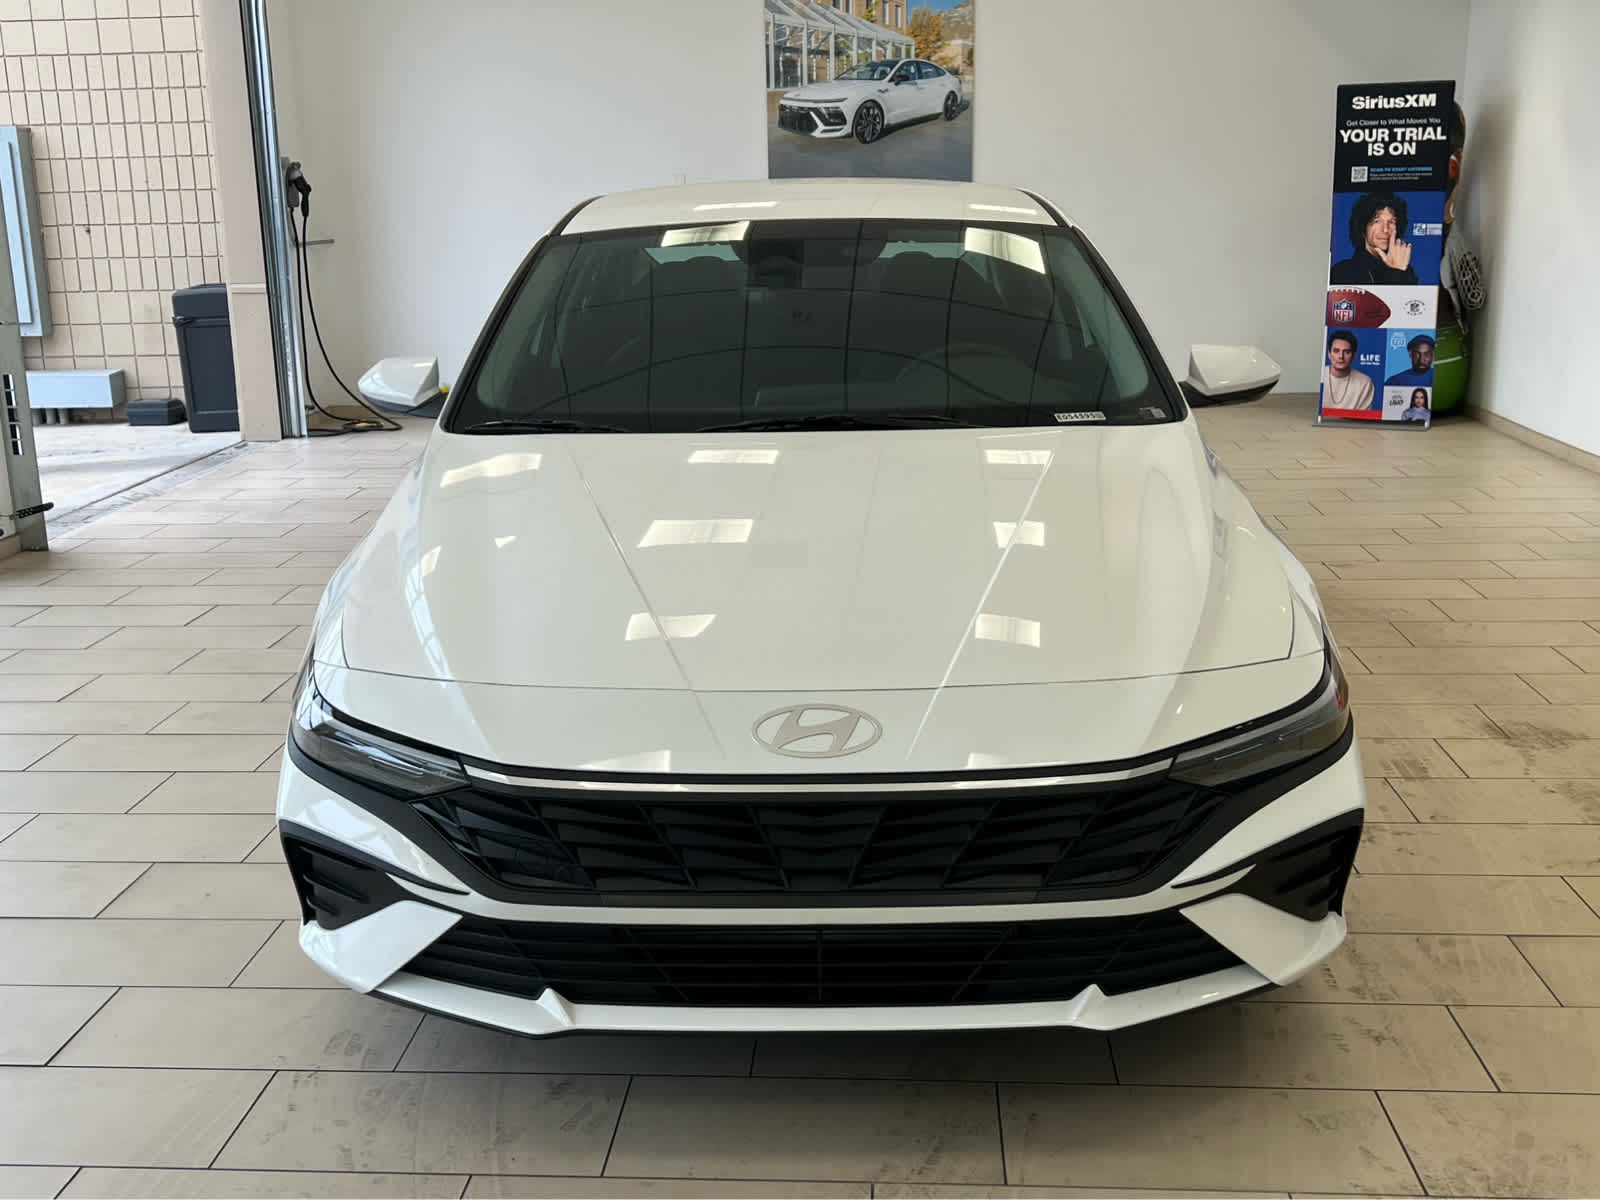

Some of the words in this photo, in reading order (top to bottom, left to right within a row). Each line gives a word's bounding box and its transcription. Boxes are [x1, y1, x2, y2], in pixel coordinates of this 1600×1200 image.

[1352, 93, 1437, 110] SiriusXM
[1339, 128, 1389, 143] YOUR
[1393, 126, 1447, 141] TRIAL
[1367, 143, 1385, 156] IS
[1388, 141, 1416, 156] ON
[1334, 310, 1352, 321] NFL
[1360, 353, 1380, 362] LIFE
